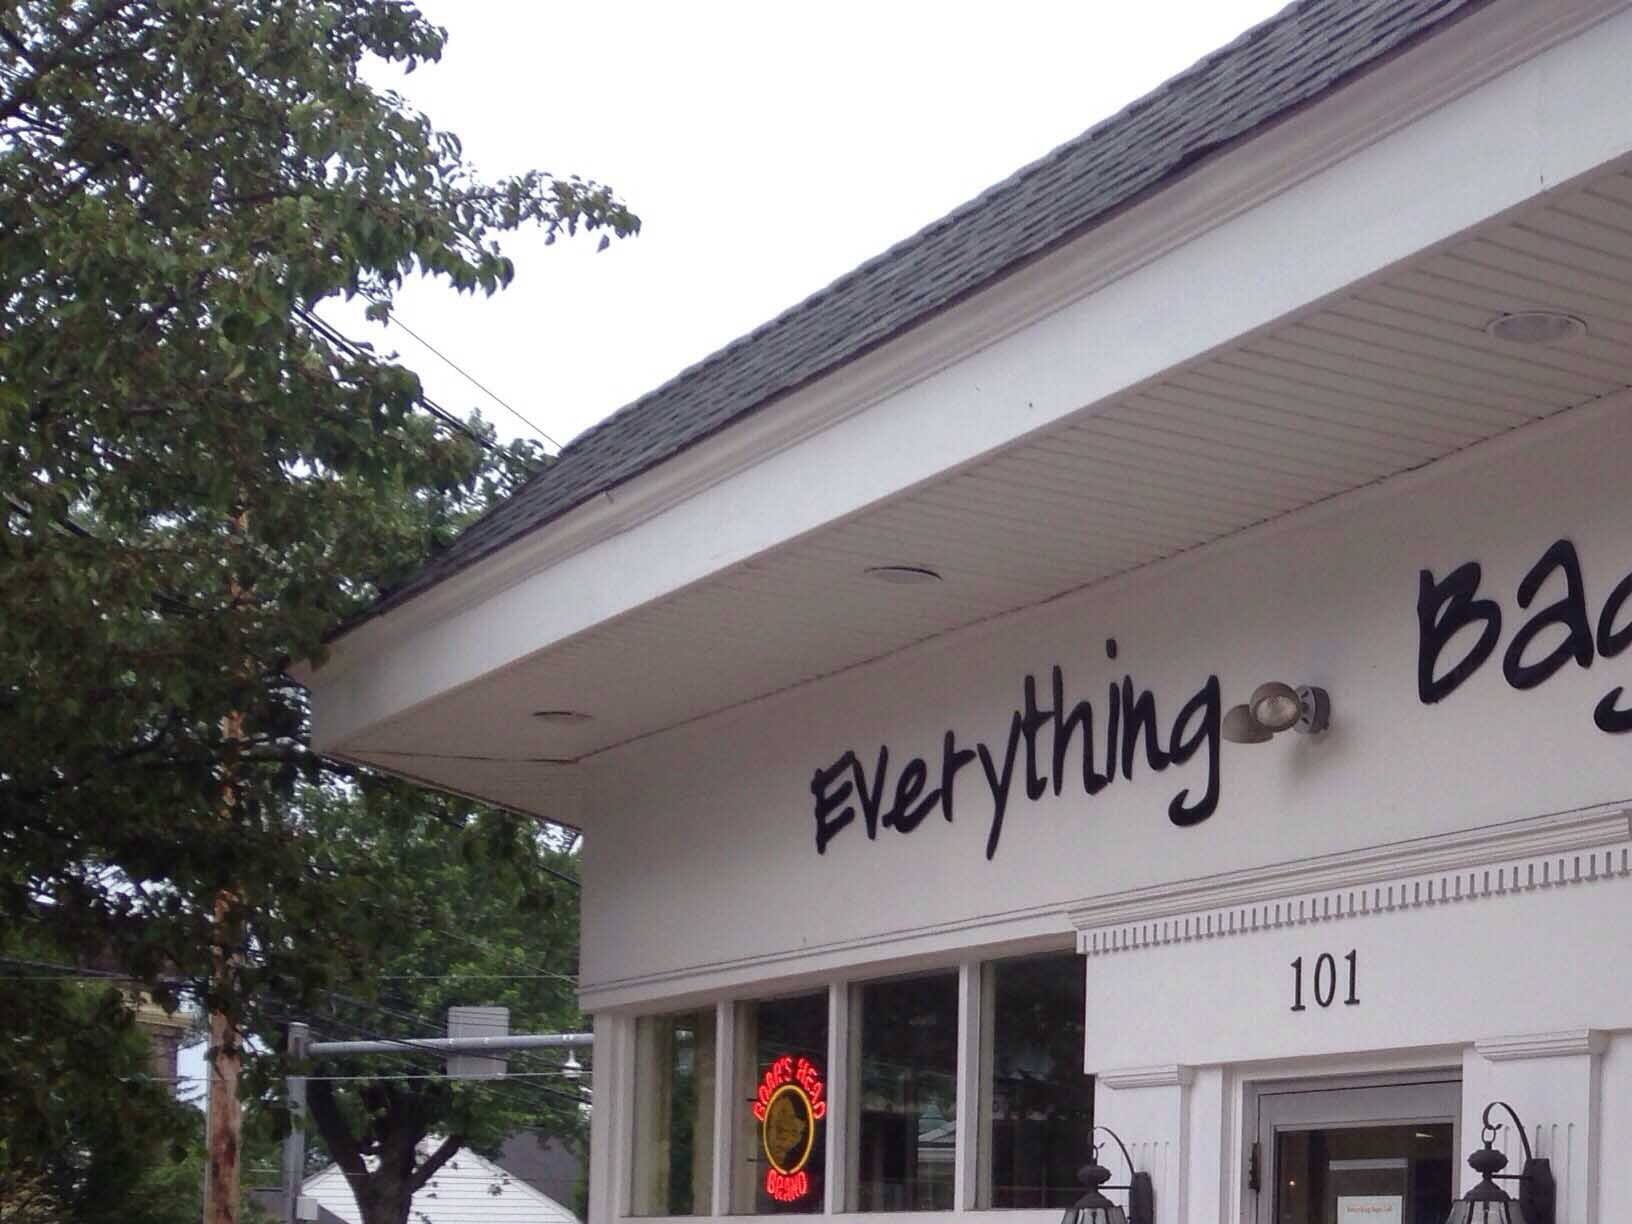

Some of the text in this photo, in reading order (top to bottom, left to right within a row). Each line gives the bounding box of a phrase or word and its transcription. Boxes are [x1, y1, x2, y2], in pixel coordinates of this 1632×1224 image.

[810, 637, 1221, 860] Everything
[1290, 948, 1360, 1012] 101
[753, 1056, 826, 1121] BOAR'S HEAD
[766, 1168, 808, 1202] BRAND
